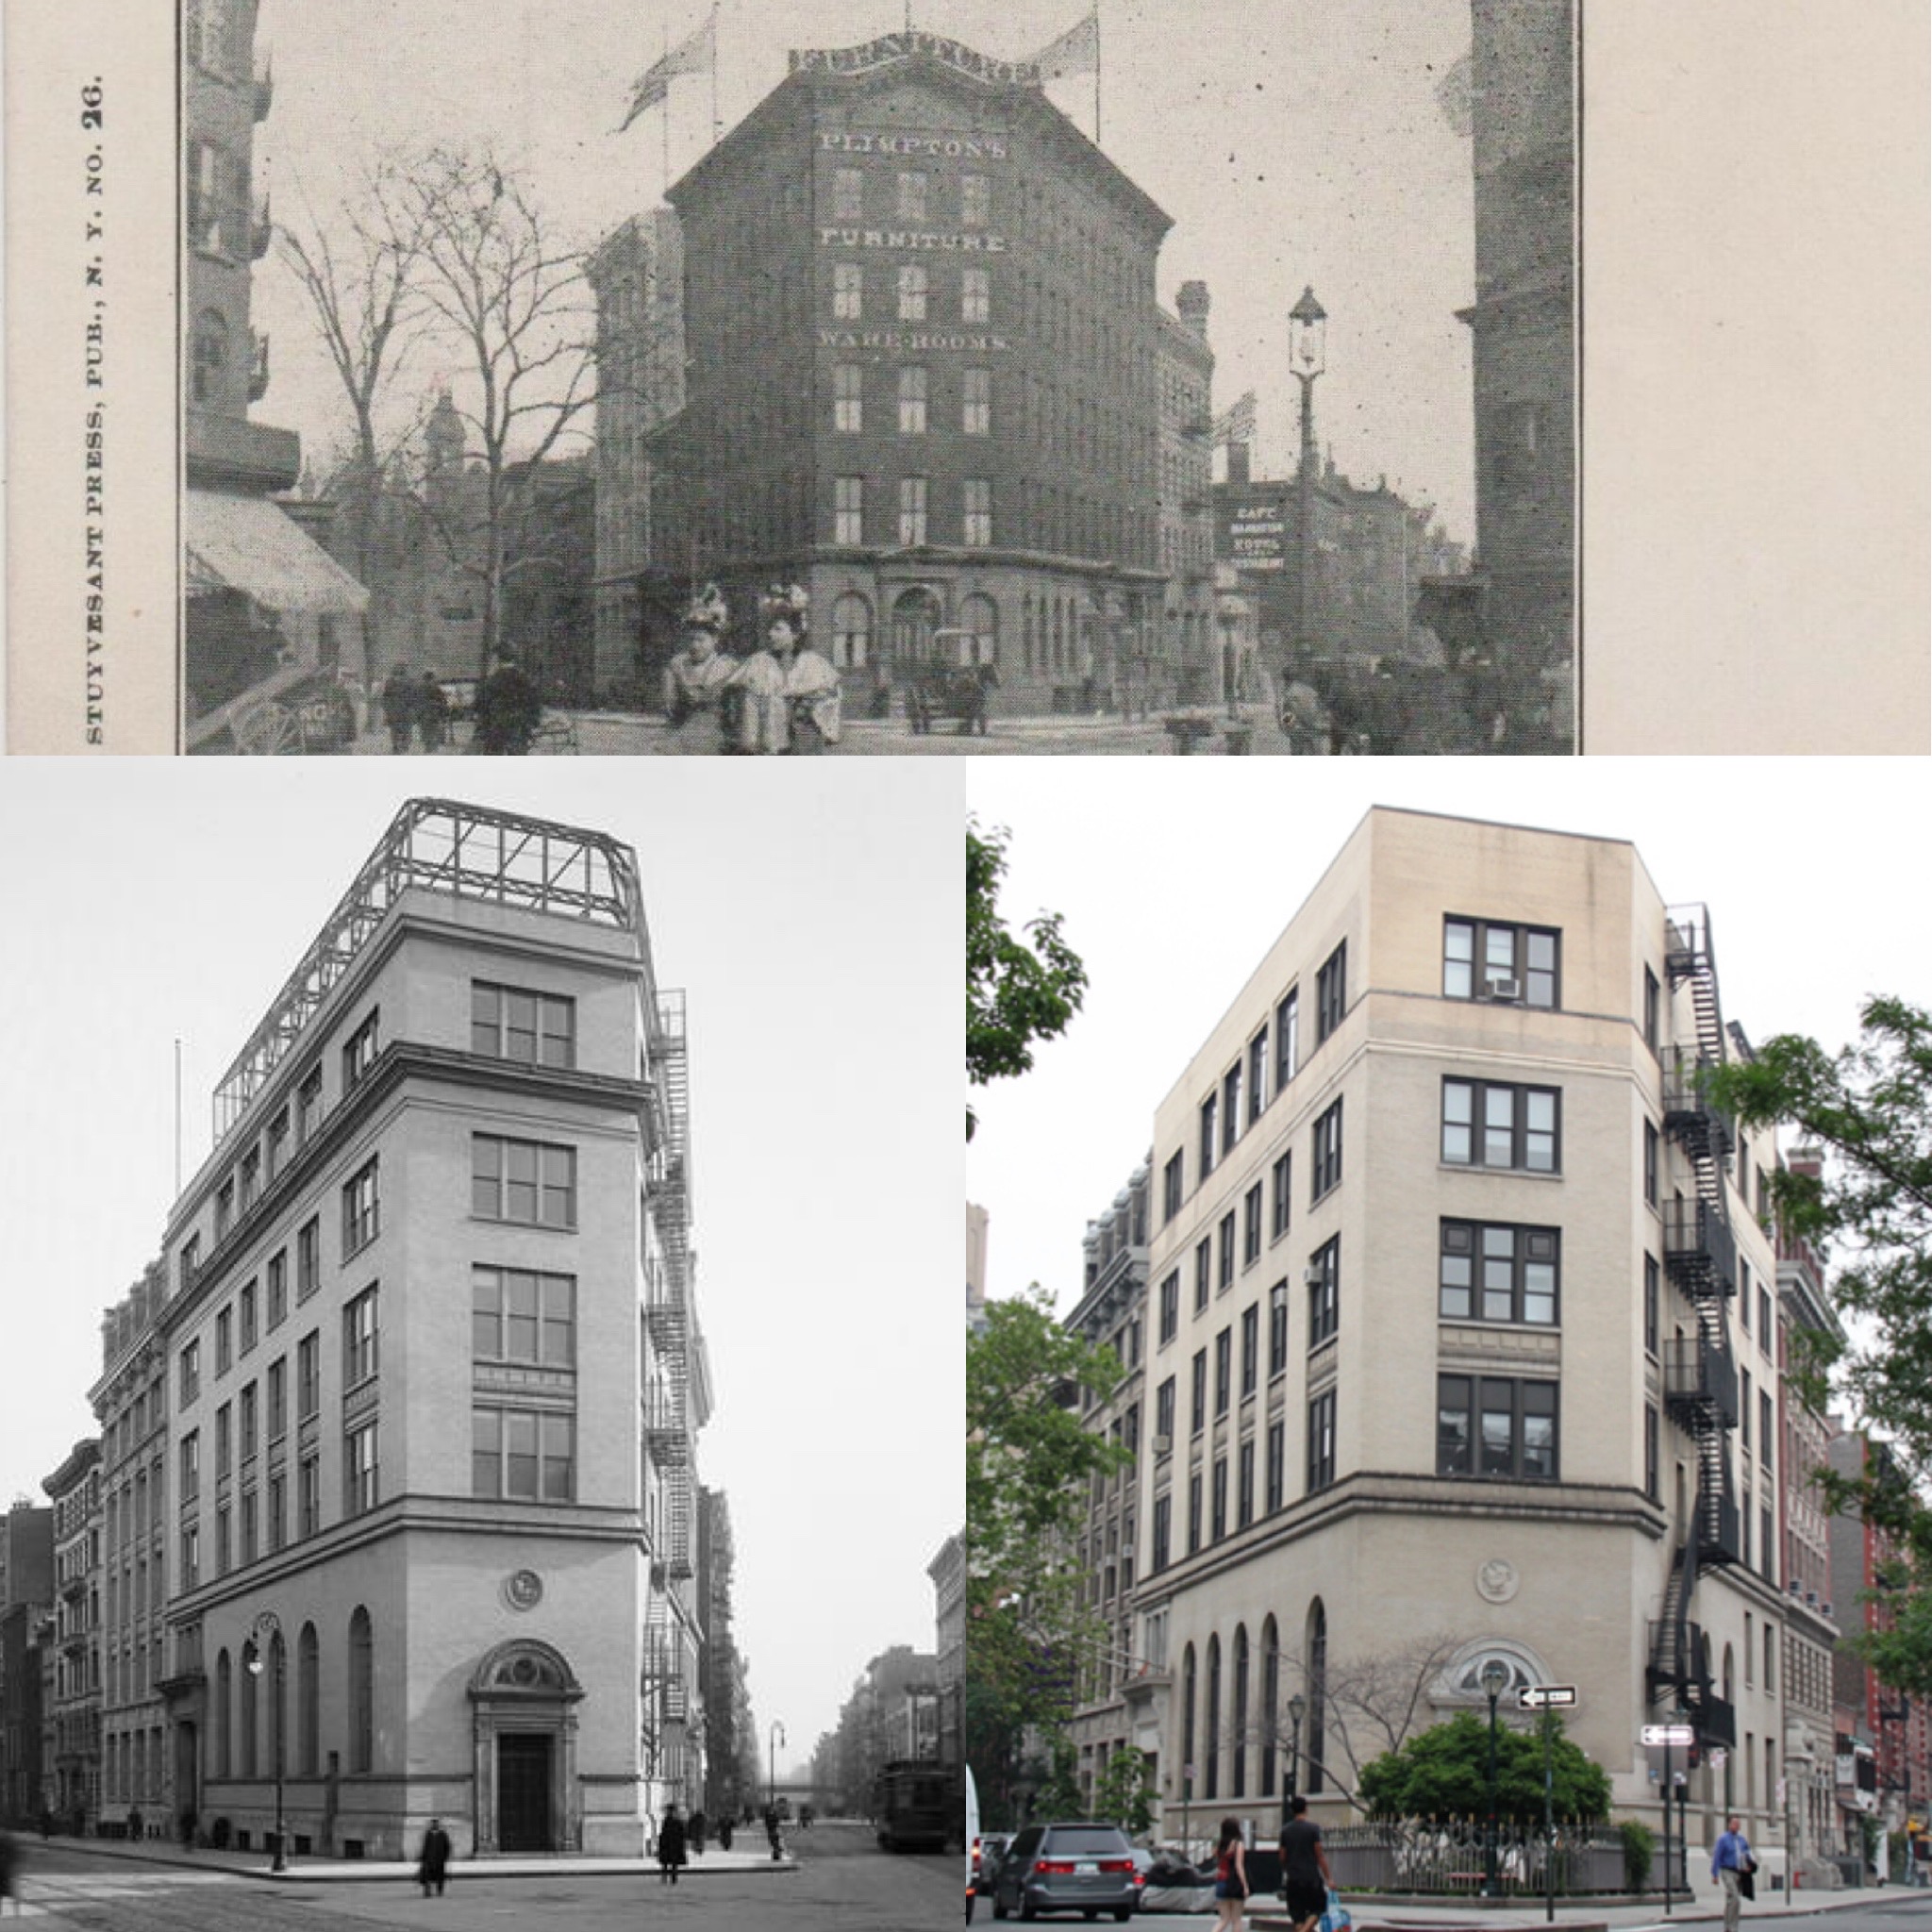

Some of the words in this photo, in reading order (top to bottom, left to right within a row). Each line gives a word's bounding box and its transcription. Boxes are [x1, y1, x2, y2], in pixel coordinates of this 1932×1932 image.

[81, 75, 102, 129] 26.
[86, 145, 102, 194] NO.
[86, 211, 102, 240] Y.
[819, 228, 1006, 252] FURNITURE
[86, 257, 102, 286] N.
[85, 301, 105, 386] PUB.,
[85, 403, 105, 515] PRESS,
[85, 526, 103, 744] STUYVESANT
